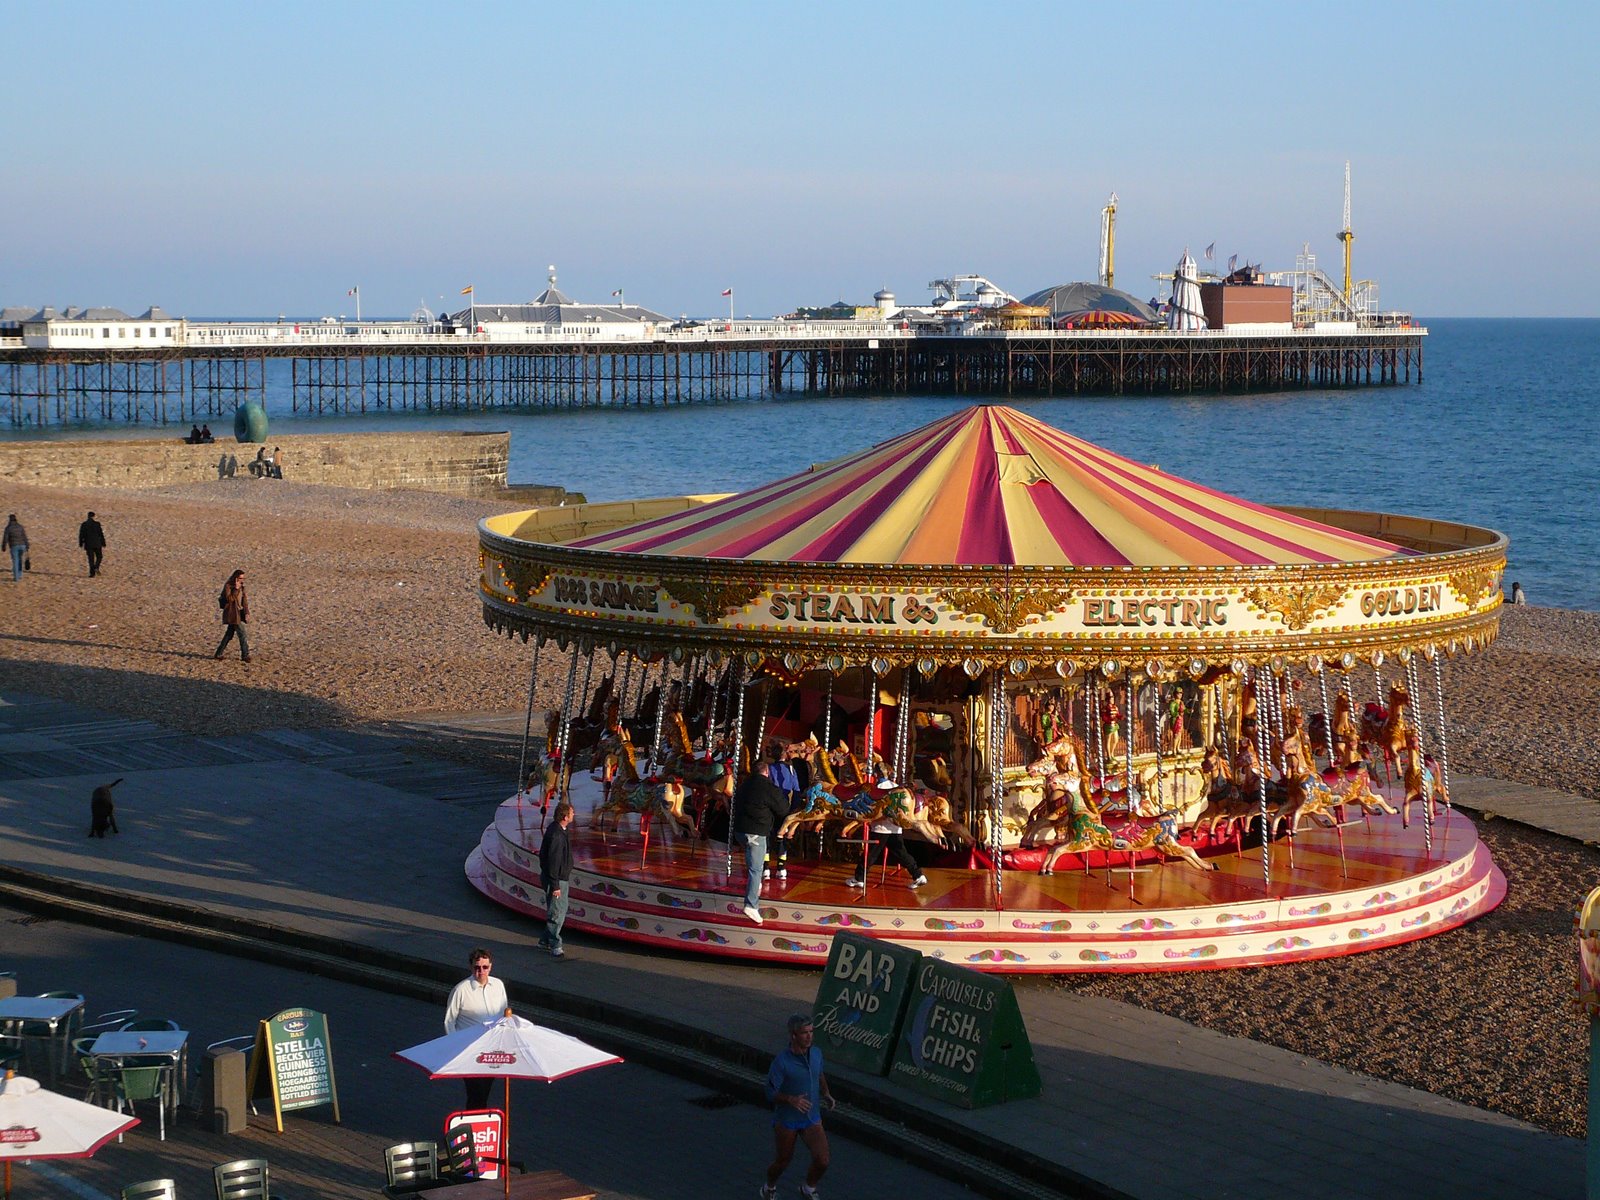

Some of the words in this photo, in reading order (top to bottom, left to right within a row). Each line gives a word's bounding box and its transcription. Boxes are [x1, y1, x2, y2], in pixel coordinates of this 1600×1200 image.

[590, 581, 658, 612] SAVAGE
[1360, 585, 1442, 617] GOLDEN
[771, 592, 896, 625] STEAM
[903, 597, 939, 624] &
[1082, 598, 1227, 629] ELECTRIC
[834, 943, 895, 992] BAR
[836, 988, 879, 1012] AND
[814, 1004, 889, 1050] Restaurant
[972, 1028, 981, 1043] &
[275, 1038, 322, 1054] STELLA
[276, 1052, 304, 1063] BECKS
[305, 1049, 325, 1059] VIER
[277, 1057, 326, 1072] GUINNESS
[278, 1067, 327, 1080] STRONGBOW
[279, 1074, 328, 1087] HOEGAARDEN
[921, 1069, 929, 1079] TO
[280, 1081, 329, 1094] BODDINGTONS
[281, 1091, 310, 1100] BOTTLED
